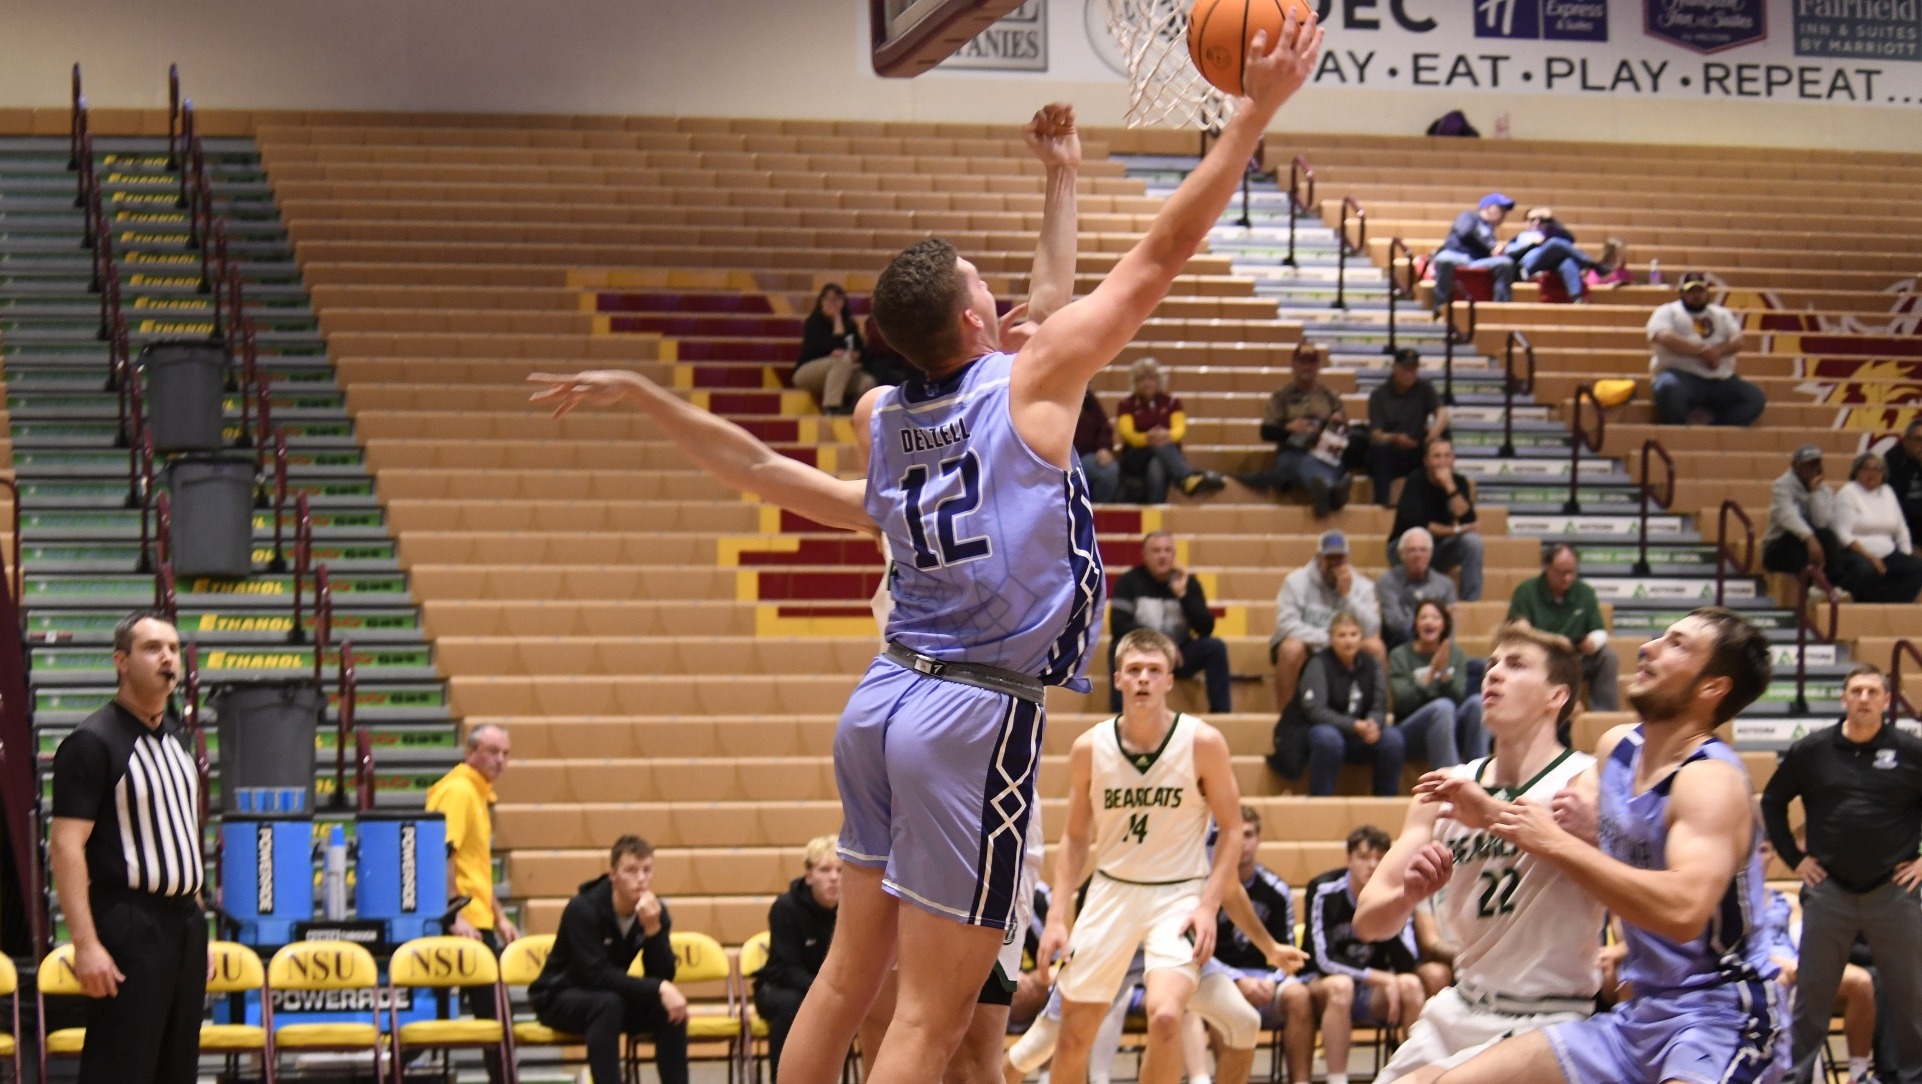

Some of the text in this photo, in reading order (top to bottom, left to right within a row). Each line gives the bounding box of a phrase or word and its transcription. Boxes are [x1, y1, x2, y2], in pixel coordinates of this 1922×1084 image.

[954, 29, 1040, 59] ANIES
[1800, 23, 1831, 36] INN
[1856, 25, 1918, 40] SUITES
[1801, 38, 1918, 56] BY MARRIOTT
[1313, 50, 1376, 84] AY
[1412, 53, 1511, 88] EAT
[1546, 57, 1669, 93] PLAY
[900, 417, 971, 454] DELZELL
[899, 447, 993, 572] 12
[192, 578, 284, 594] ETHANOL
[199, 613, 294, 632] ETHANOL
[206, 650, 303, 669] ETHANOL
[1104, 786, 1184, 810] BEARCATS
[1122, 813, 1149, 845] 14
[258, 827, 274, 913] POWERADE
[401, 826, 417, 912] POWERADE
[1478, 867, 1519, 917] 22
[287, 951, 356, 982] NSU
[410, 947, 478, 978] NSU
[271, 987, 410, 1012] POWERADE
